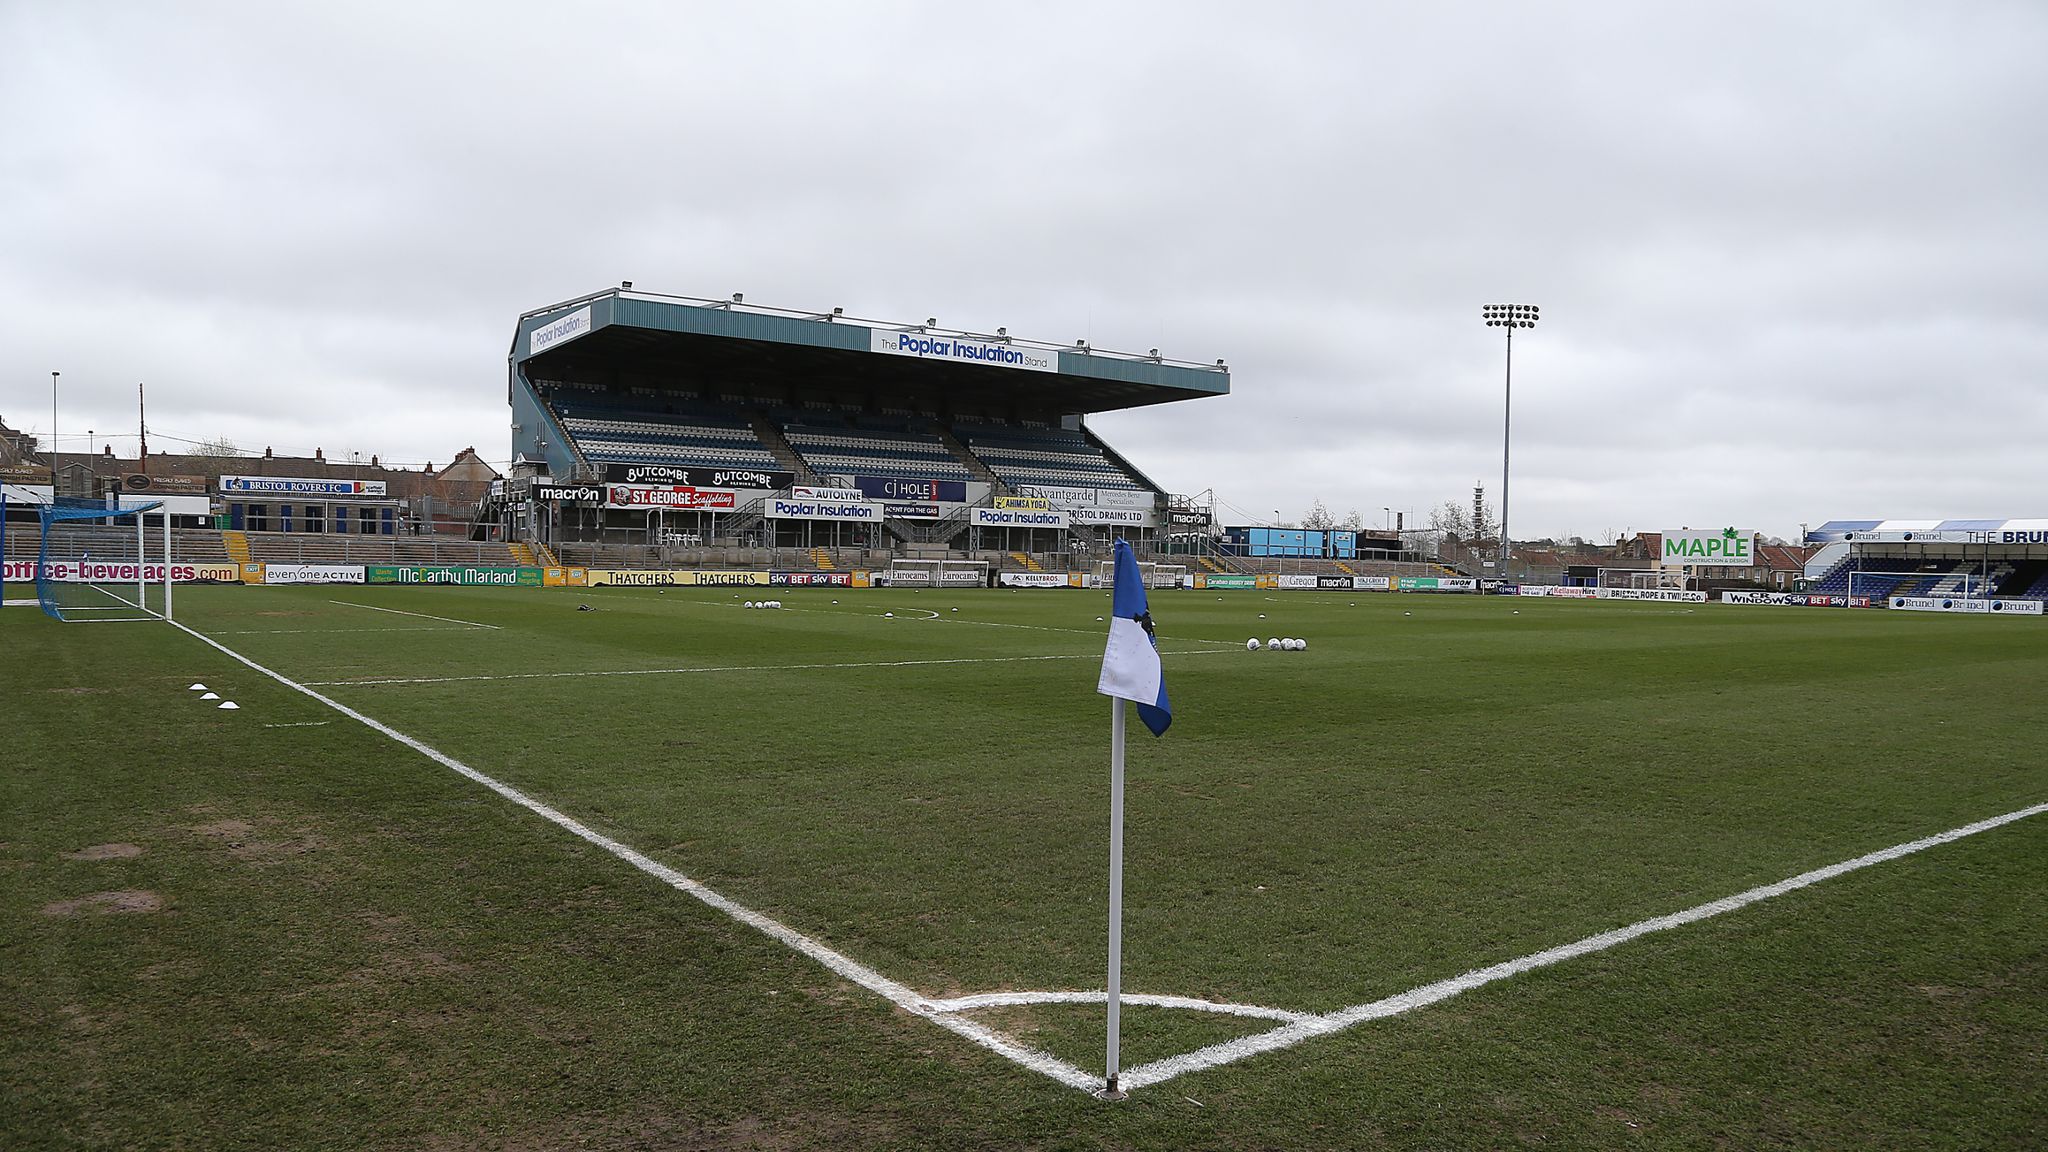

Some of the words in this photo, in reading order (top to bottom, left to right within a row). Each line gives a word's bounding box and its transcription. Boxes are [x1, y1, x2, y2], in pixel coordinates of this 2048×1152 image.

[536, 328, 554, 347] Poplar
[554, 317, 580, 338] Insulation
[882, 339, 897, 350] The
[900, 334, 950, 356] Poplar
[953, 340, 1023, 364] Insulation
[1025, 357, 1048, 368] Stand
[626, 467, 690, 484] BUTCOMBE
[712, 472, 772, 488] BUTCOMBE
[250, 482, 290, 491] BRISTOL
[291, 482, 326, 492] ROVERS
[329, 484, 341, 492] FC
[900, 483, 930, 494] HOLE
[540, 487, 598, 500] macron
[633, 490, 648, 503] ST.
[650, 491, 691, 504] GEORGE
[692, 493, 732, 507] Scaffolding
[816, 490, 860, 500] AUTOLYNE
[1036, 488, 1093, 502] Avantgarde
[1006, 499, 1029, 508] AHIMSA
[1030, 500, 1046, 509] YOGA
[775, 502, 815, 516] Poplar
[817, 504, 872, 518] Insulation
[1099, 510, 1127, 520] DRAINS
[1129, 512, 1142, 520] LTD
[980, 510, 1012, 523] Poplar
[1014, 513, 1060, 524] Insulation
[1173, 514, 1206, 524] macron
[1853, 532, 1880, 540] Brunel
[1913, 532, 1942, 541] Brunel
[1966, 531, 1997, 544] THE
[1666, 538, 1748, 556] MAPLE
[399, 568, 461, 584] McCarthy
[465, 569, 516, 584] Marland
[608, 572, 674, 585] THATCHERS
[693, 572, 755, 585] THATCHERS
[771, 574, 787, 584] sky
[791, 574, 808, 584] BET
[812, 574, 828, 584] sky
[832, 575, 848, 584] BET
[892, 571, 928, 580] Eurocams
[942, 571, 977, 580] Eurocams
[1289, 576, 1315, 587] Gregor
[1321, 578, 1350, 587] macron
[1640, 591, 1658, 599] ROPE
[1667, 592, 1690, 601] TWIE
[1730, 593, 1792, 604] WINDOWS
[1792, 596, 1807, 605] sky
[1831, 596, 1846, 606] sky
[1906, 599, 1934, 608] Brunel
[2004, 601, 2036, 610] Brunel
